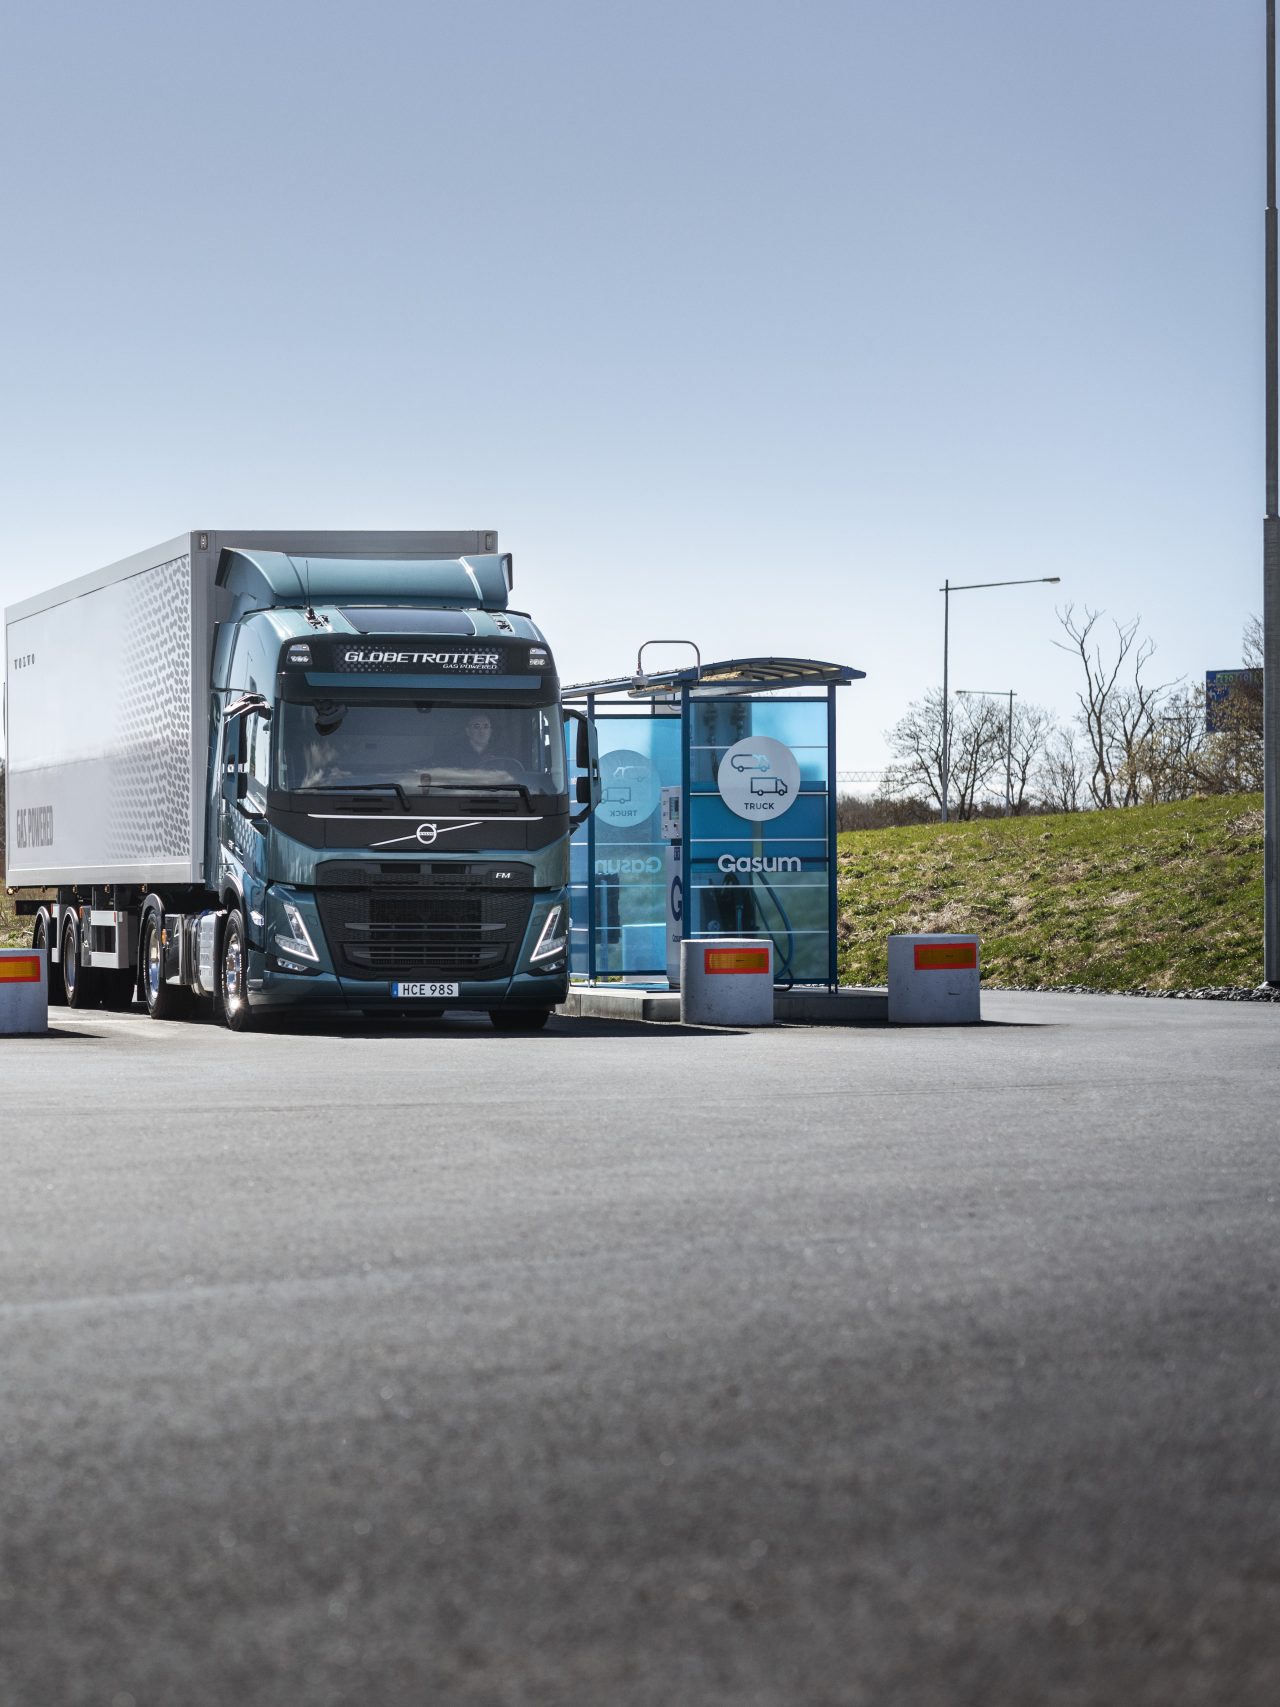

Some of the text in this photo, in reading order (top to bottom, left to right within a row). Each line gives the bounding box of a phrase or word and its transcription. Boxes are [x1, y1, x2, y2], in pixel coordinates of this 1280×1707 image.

[344, 651, 499, 665] GLOBETROTTER
[744, 802, 774, 810] TRUCK
[16, 808, 27, 849] GAS
[718, 854, 802, 873] Gasum
[403, 984, 454, 996] HCE 98S
